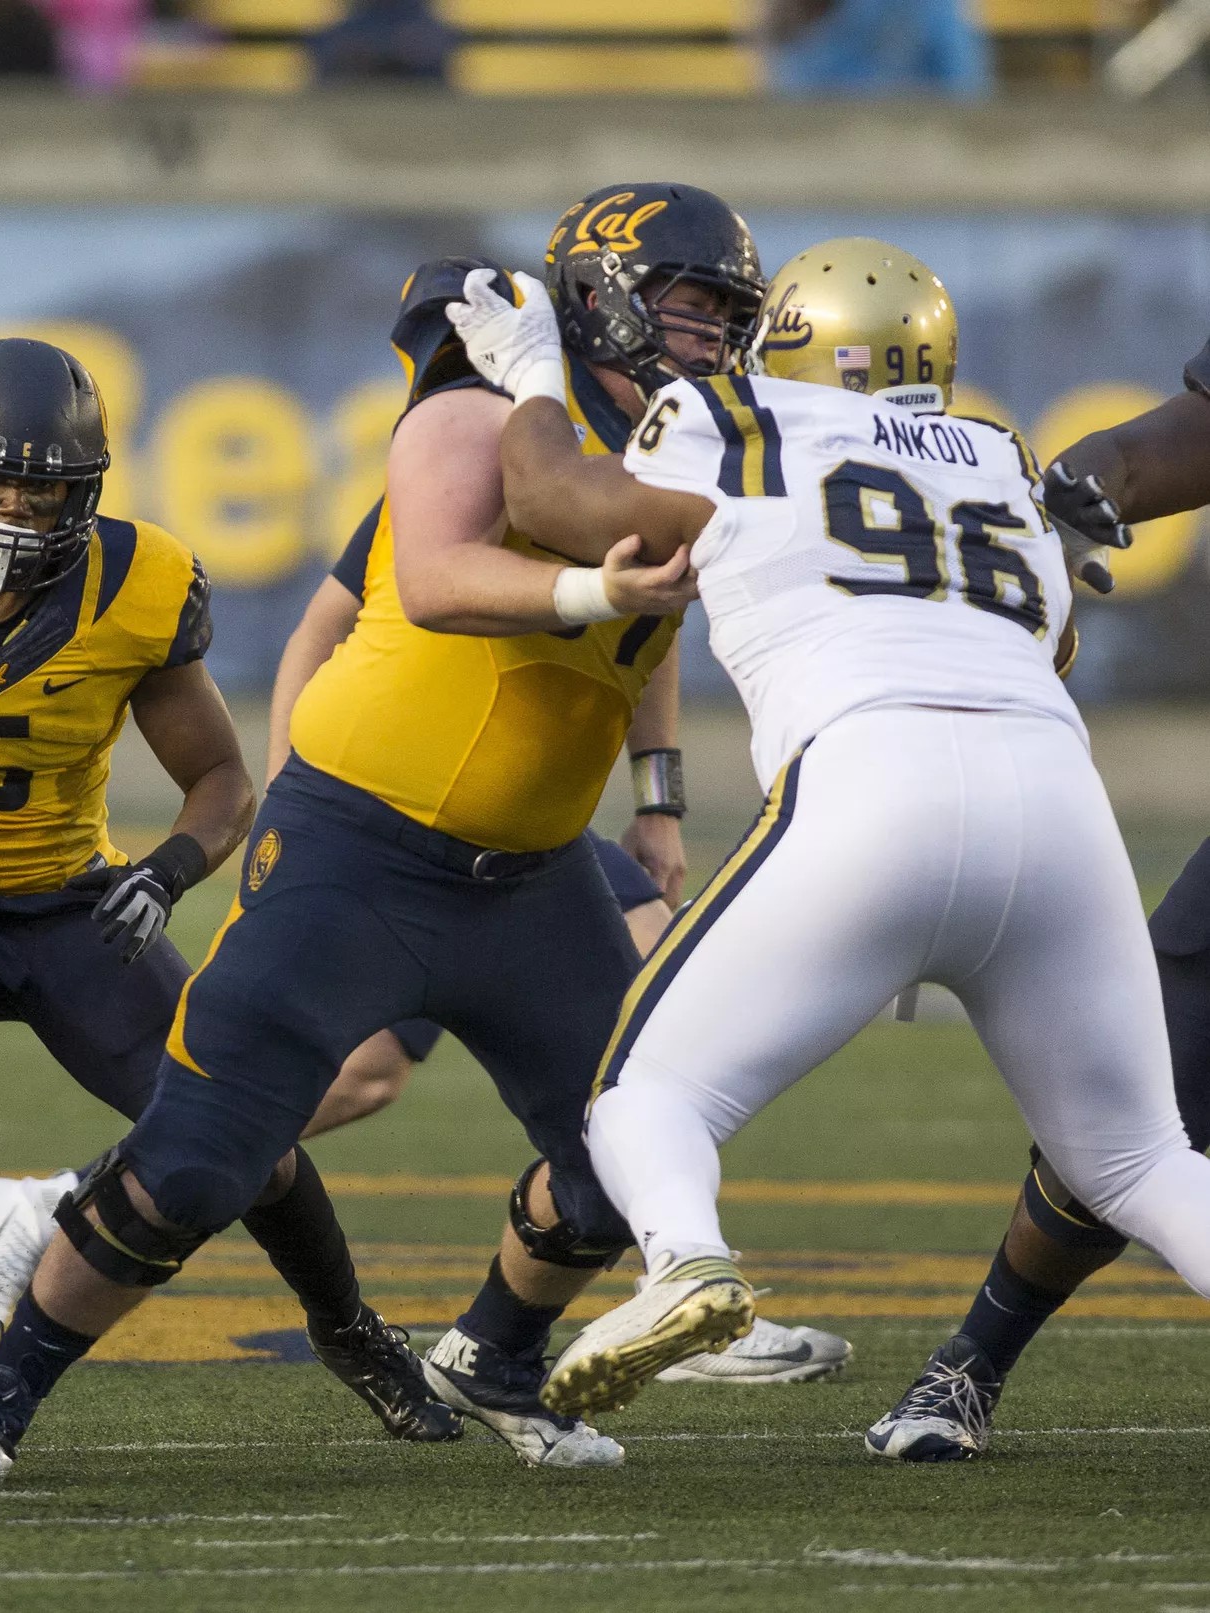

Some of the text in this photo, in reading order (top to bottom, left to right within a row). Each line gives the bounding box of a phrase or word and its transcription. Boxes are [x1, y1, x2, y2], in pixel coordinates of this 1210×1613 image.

[567, 192, 668, 255] Cal
[886, 343, 933, 385] 96
[873, 414, 979, 467] ANKOU
[820, 458, 1050, 642] 96
